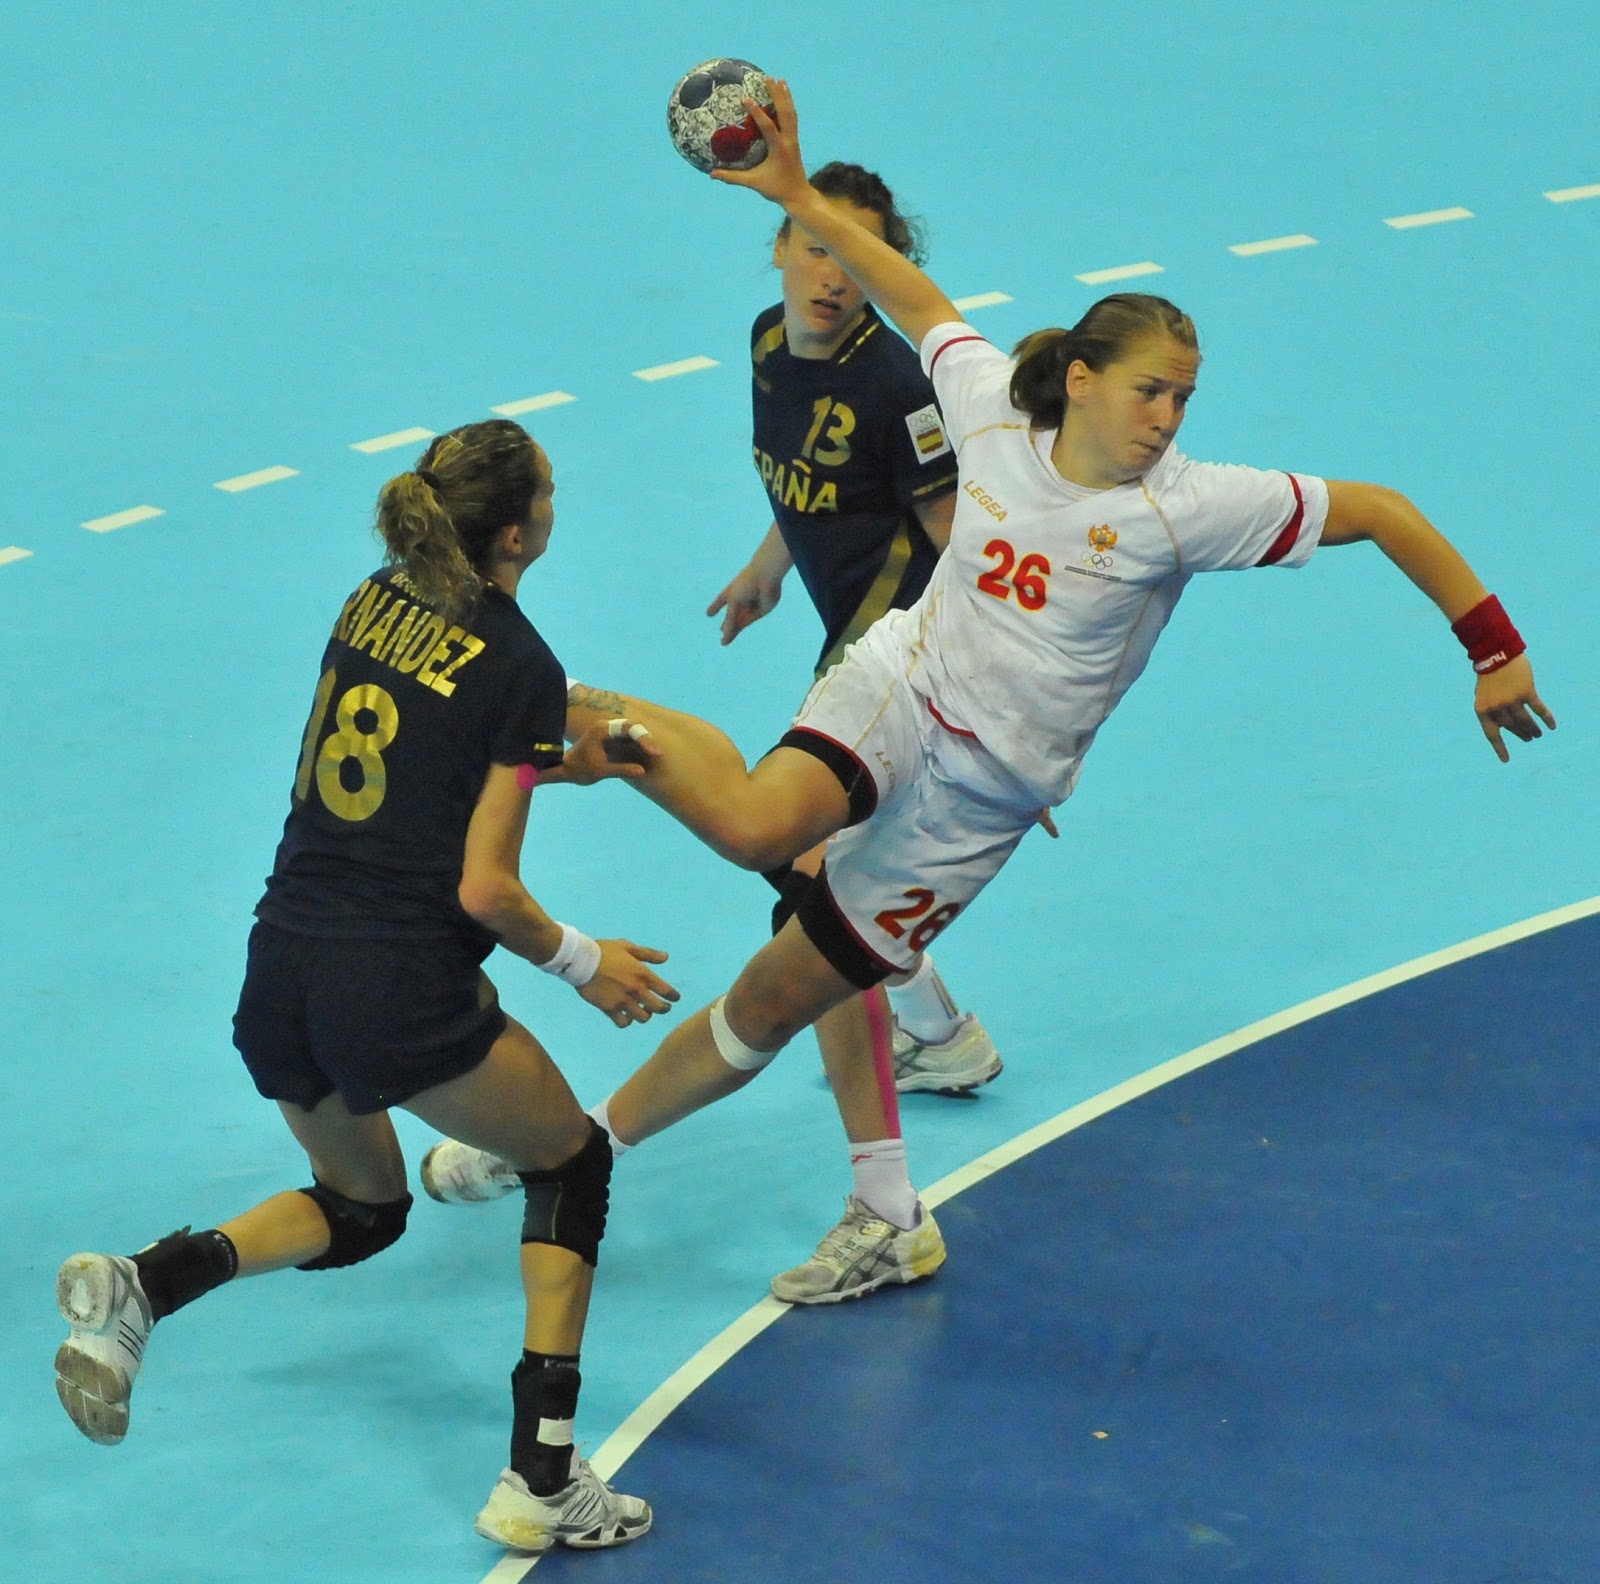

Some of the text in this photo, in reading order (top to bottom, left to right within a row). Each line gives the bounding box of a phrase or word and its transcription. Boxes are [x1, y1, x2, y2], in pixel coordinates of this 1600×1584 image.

[802, 396, 856, 466] 13
[753, 447, 838, 513] PAÑA
[963, 480, 1008, 522] LEGEA
[977, 538, 1051, 611] 26
[295, 666, 399, 821] 18
[874, 887, 960, 951] 26
